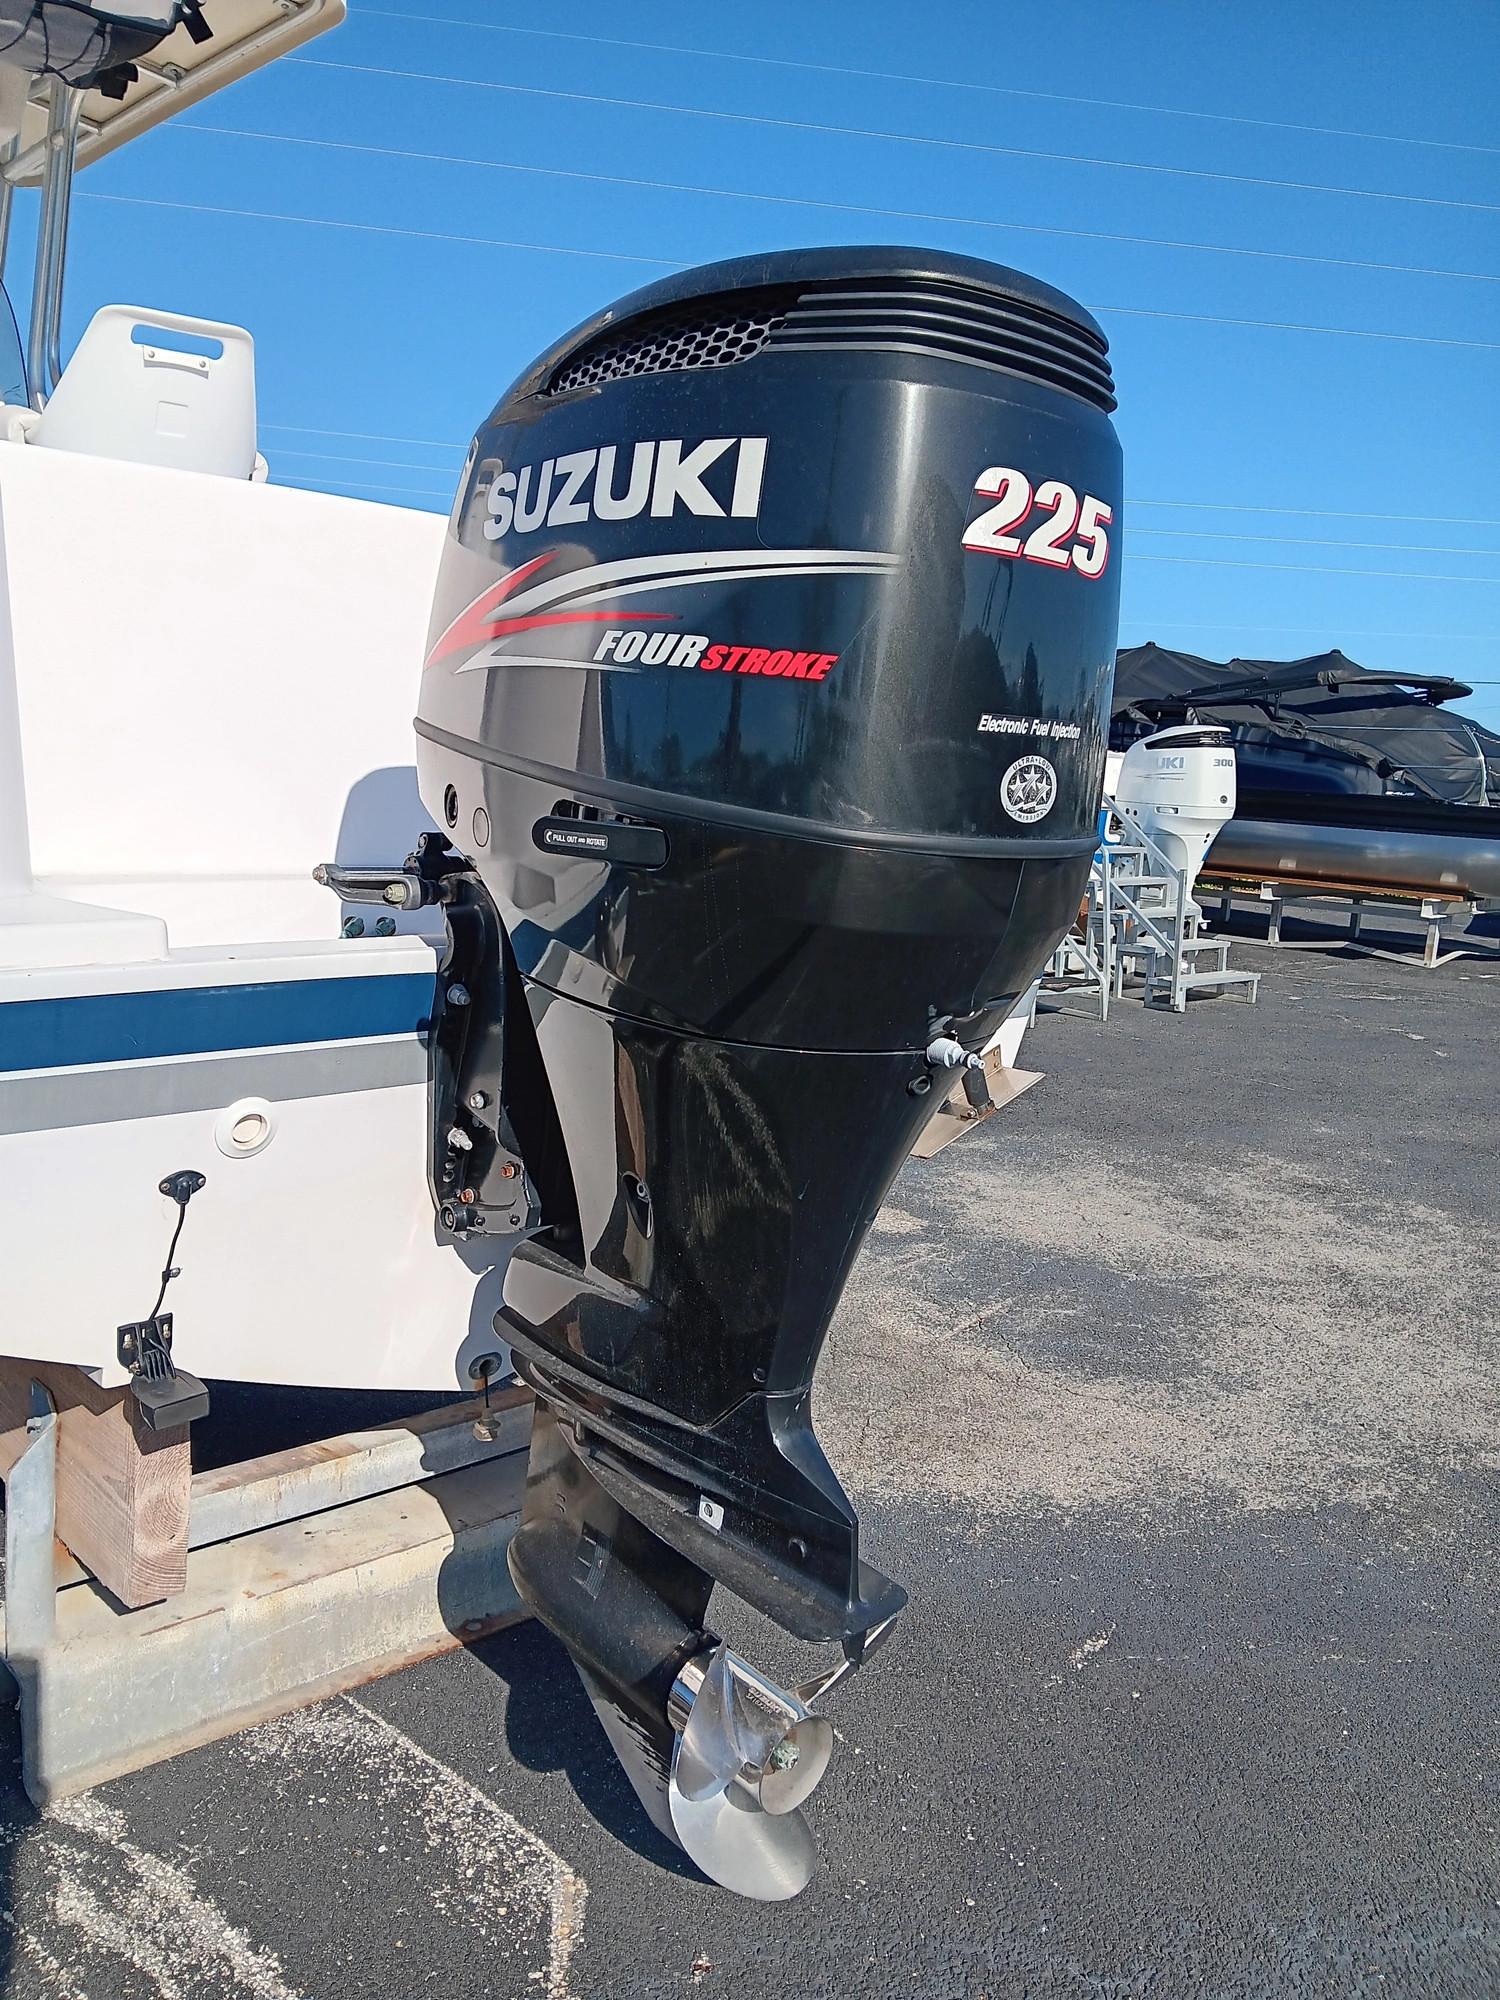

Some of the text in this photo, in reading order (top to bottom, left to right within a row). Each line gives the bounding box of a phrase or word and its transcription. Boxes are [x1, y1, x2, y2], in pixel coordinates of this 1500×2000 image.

[483, 437, 768, 541] SUZUKI
[962, 467, 1113, 580] 225
[592, 630, 840, 680] FOUR STROKE
[977, 715, 1081, 741] Electronic Fuel Injection
[1213, 758, 1234, 767] 300
[553, 834, 566, 842] PULL
[566, 835, 578, 843] OUT
[586, 837, 606, 847] ROTATE
